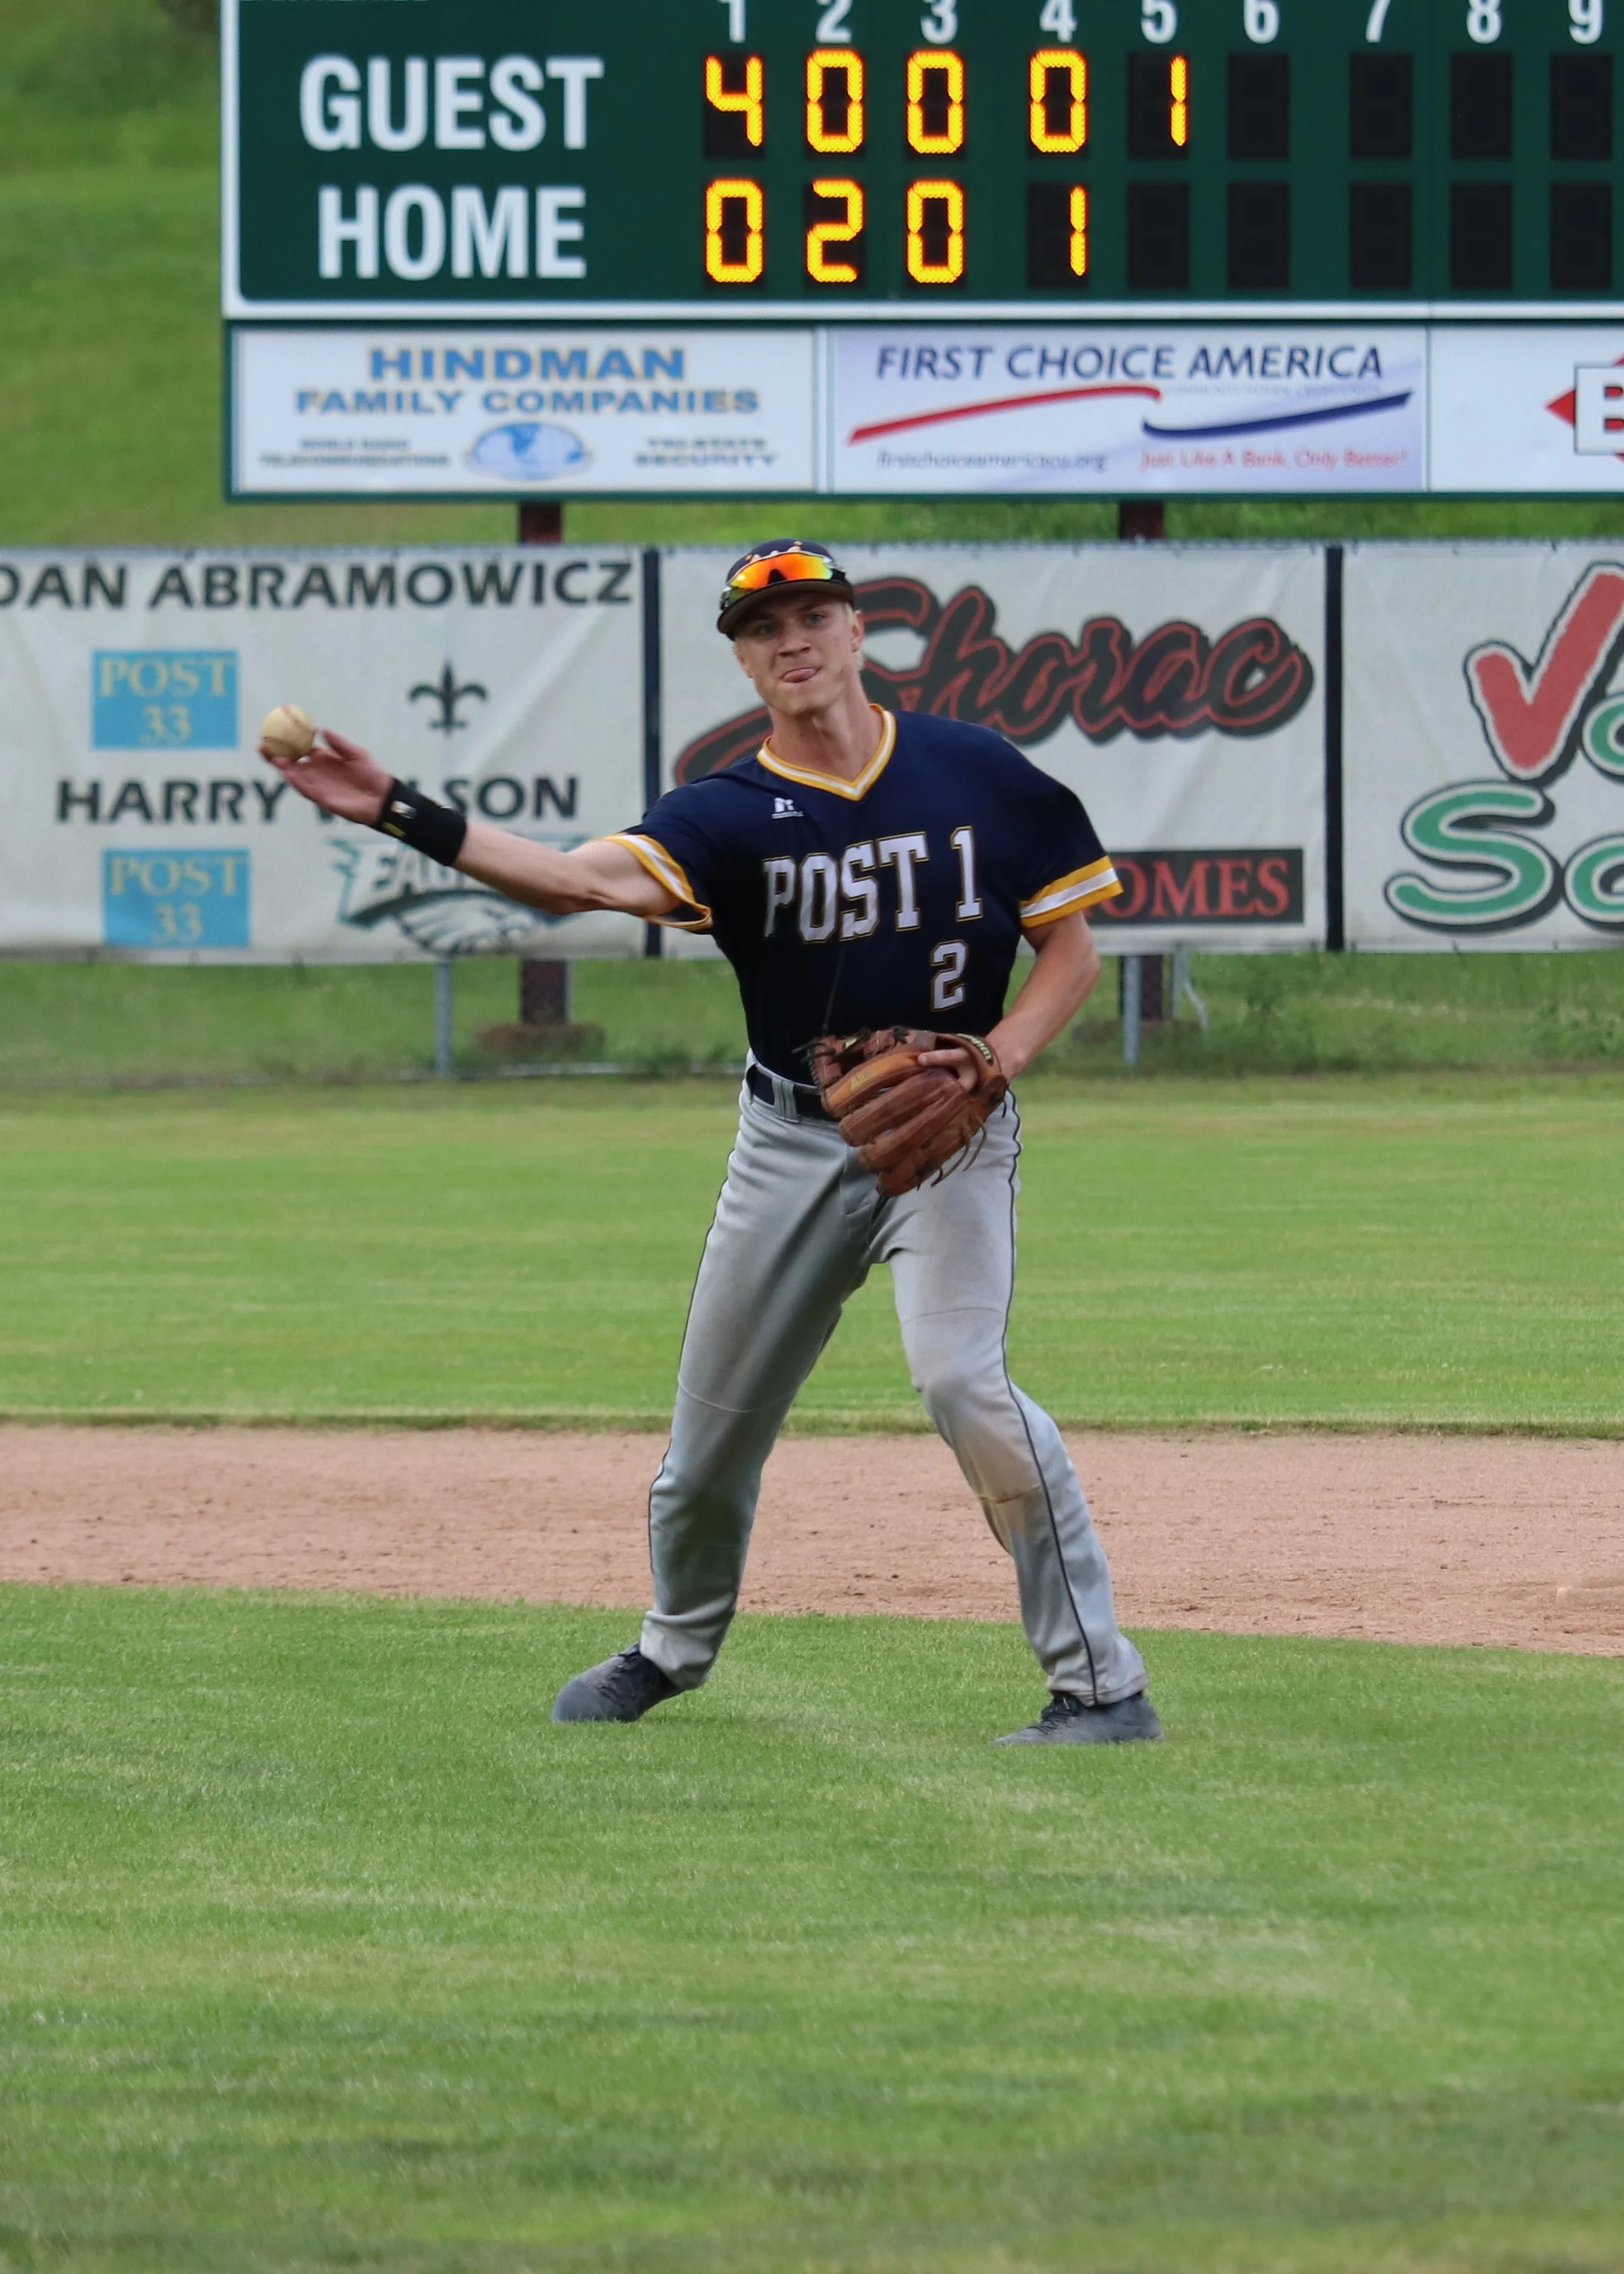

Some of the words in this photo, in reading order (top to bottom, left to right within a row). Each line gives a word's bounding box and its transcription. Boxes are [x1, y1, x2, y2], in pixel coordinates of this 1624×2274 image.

[727, 0, 747, 42] 1
[816, 0, 852, 43] 2
[920, 0, 958, 43] 3
[1039, 0, 1077, 43] 4
[1140, 0, 1178, 43] 5
[1243, 0, 1279, 43] 6
[1365, 0, 1392, 42] 7
[1466, 0, 1502, 43] 8
[1568, 0, 1604, 43] 9
[299, 54, 604, 151] GUEST
[705, 55, 764, 147] 4
[806, 48, 864, 153] 0
[906, 49, 964, 154] 0
[1030, 48, 1088, 153] 0
[1169, 54, 1188, 147] 1
[318, 183, 587, 280] HOME
[705, 178, 764, 283] 0
[806, 178, 864, 283] 2
[906, 178, 964, 284] 0
[1069, 185, 1088, 277] 1
[371, 348, 684, 381] HINDMAN
[877, 345, 994, 380] FIRST
[1006, 344, 1176, 380] CHOICE
[1189, 345, 1383, 380] AMERICA
[296, 389, 464, 415] FAMILY
[481, 389, 759, 415] COMPANIES
[634, 453, 776, 467] SECURITY
[1294, 448, 1336, 472] Only
[149, 562, 633, 609] ABRAMOWICZ
[99, 656, 232, 697] POST
[141, 704, 192, 744] 33
[57, 779, 289, 823] HARRY
[110, 856, 244, 896] POST
[762, 830, 930, 944] POST
[950, 825, 984, 922] 1
[1082, 857, 1291, 919] OMES
[154, 903, 204, 943] 33
[930, 939, 969, 1012] 2
